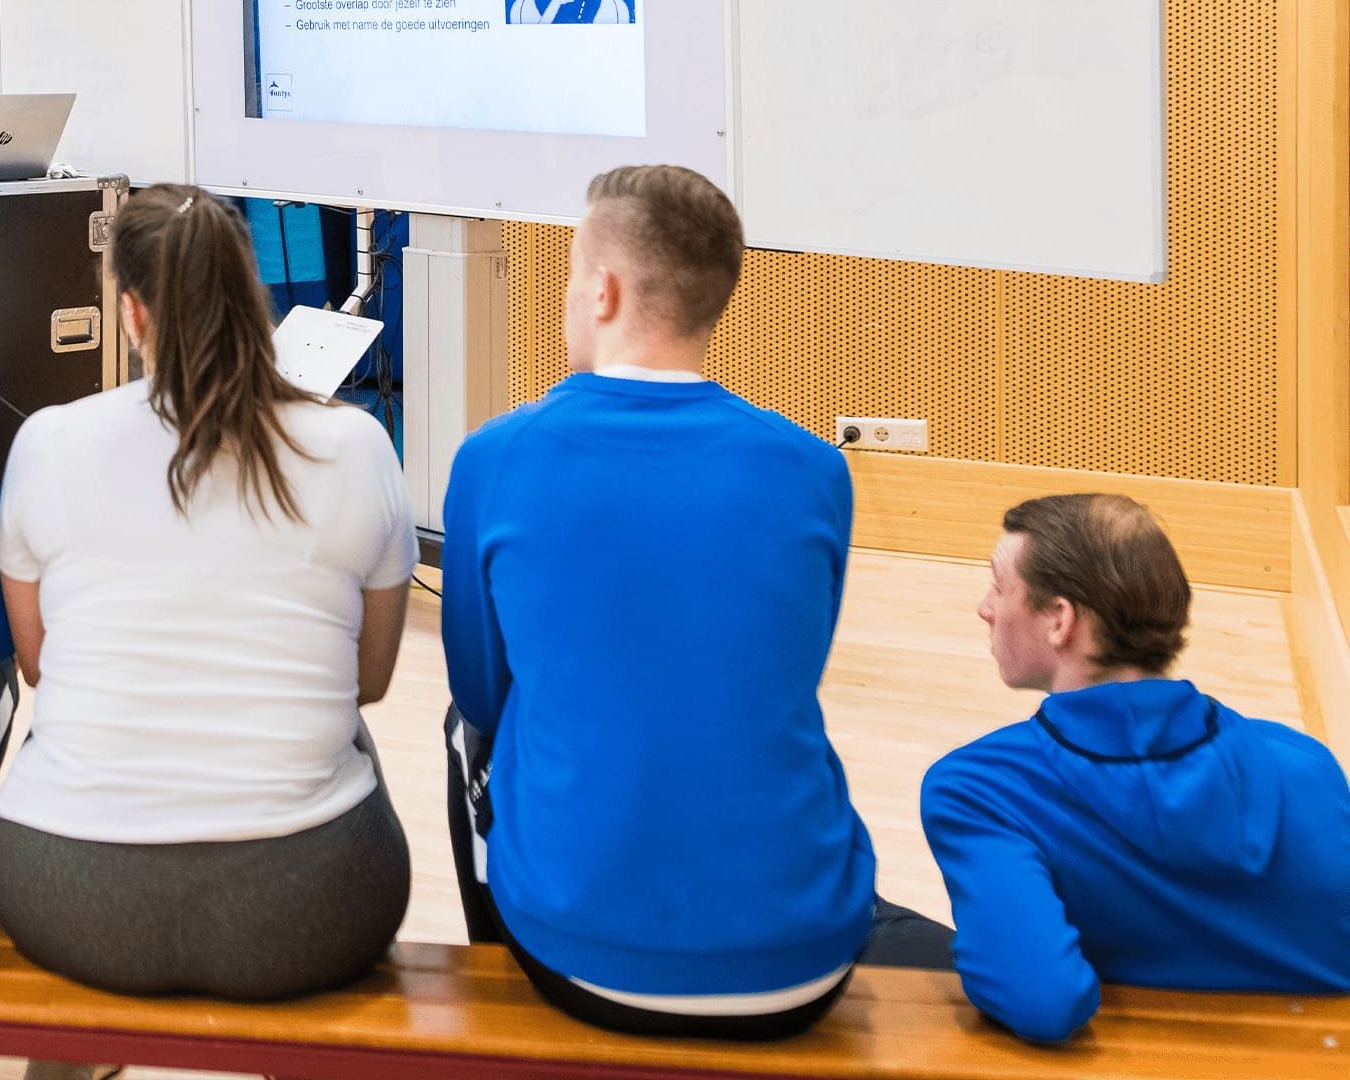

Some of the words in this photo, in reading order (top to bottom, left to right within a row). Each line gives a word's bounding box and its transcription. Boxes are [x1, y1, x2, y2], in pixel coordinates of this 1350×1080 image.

[295, 0, 333, 10] Grootste
[296, 19, 331, 31] Gebruik
[333, 19, 351, 31] met
[352, 20, 379, 30] name
[381, 18, 393, 30] de
[395, 19, 426, 33] goede
[428, 18, 490, 33] uitvoeringen
